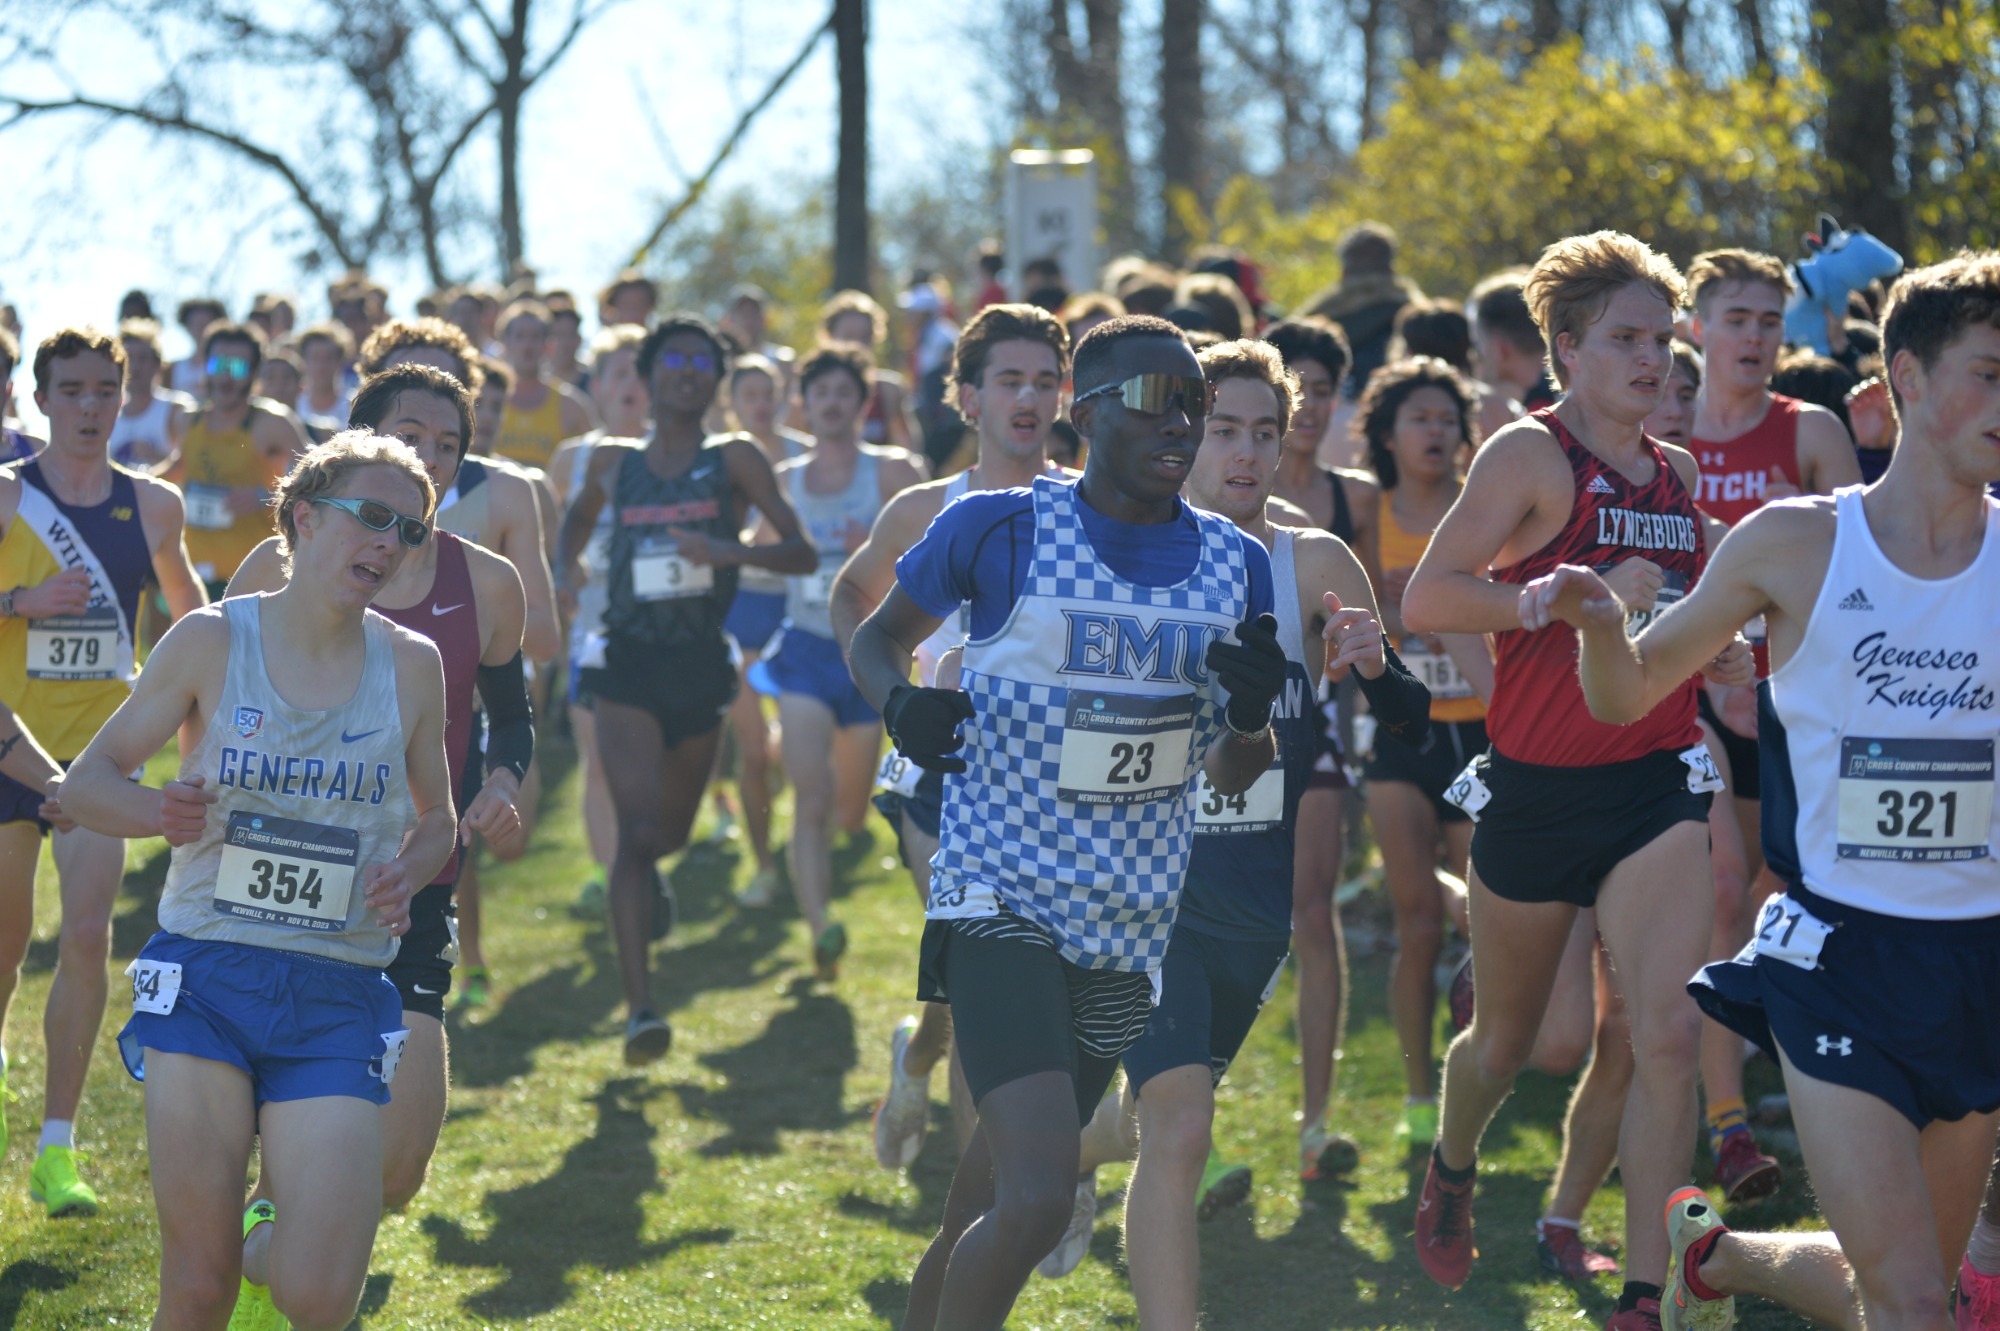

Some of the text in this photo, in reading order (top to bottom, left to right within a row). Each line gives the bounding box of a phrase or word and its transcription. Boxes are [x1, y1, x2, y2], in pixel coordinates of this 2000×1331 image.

[1597, 507, 1696, 553] LYNCHBURG
[667, 561, 682, 585] 3
[1838, 600, 1874, 611] adidas
[49, 636, 100, 667] 379
[1056, 609, 1230, 687] EMU
[1853, 631, 1980, 678] Geneseo
[1866, 672, 1996, 720] Knights
[240, 713, 258, 728] 50
[1090, 712, 1192, 726] CROSS COUNTRY CHAMPIONSHIPS
[218, 747, 391, 805] GENERALS
[1106, 741, 1155, 784] 23
[1867, 760, 1992, 772] CROSS COUNTRY CHAMPIONSHIPS
[1077, 793, 1112, 803] NEWVILLE,
[1114, 795, 1124, 803] PA
[1134, 793, 1146, 802] NOV
[1877, 789, 1957, 838] 321
[1211, 825, 1220, 833] PA
[1230, 825, 1243, 833] NOV
[247, 832, 271, 844] CROSS
[270, 837, 302, 849] COUNTRY
[302, 842, 355, 857] CHAMPIONSHIPS
[1859, 848, 1899, 860] NEWVILLE,
[1902, 850, 1913, 860] PA
[1926, 850, 1943, 860] NOV
[248, 859, 323, 910] 354
[231, 905, 263, 919] NEWVILLE,
[266, 912, 276, 921] PA
[287, 916, 301, 925] NOV
[312, 920, 330, 929] 2023
[1759, 904, 1802, 948] 21
